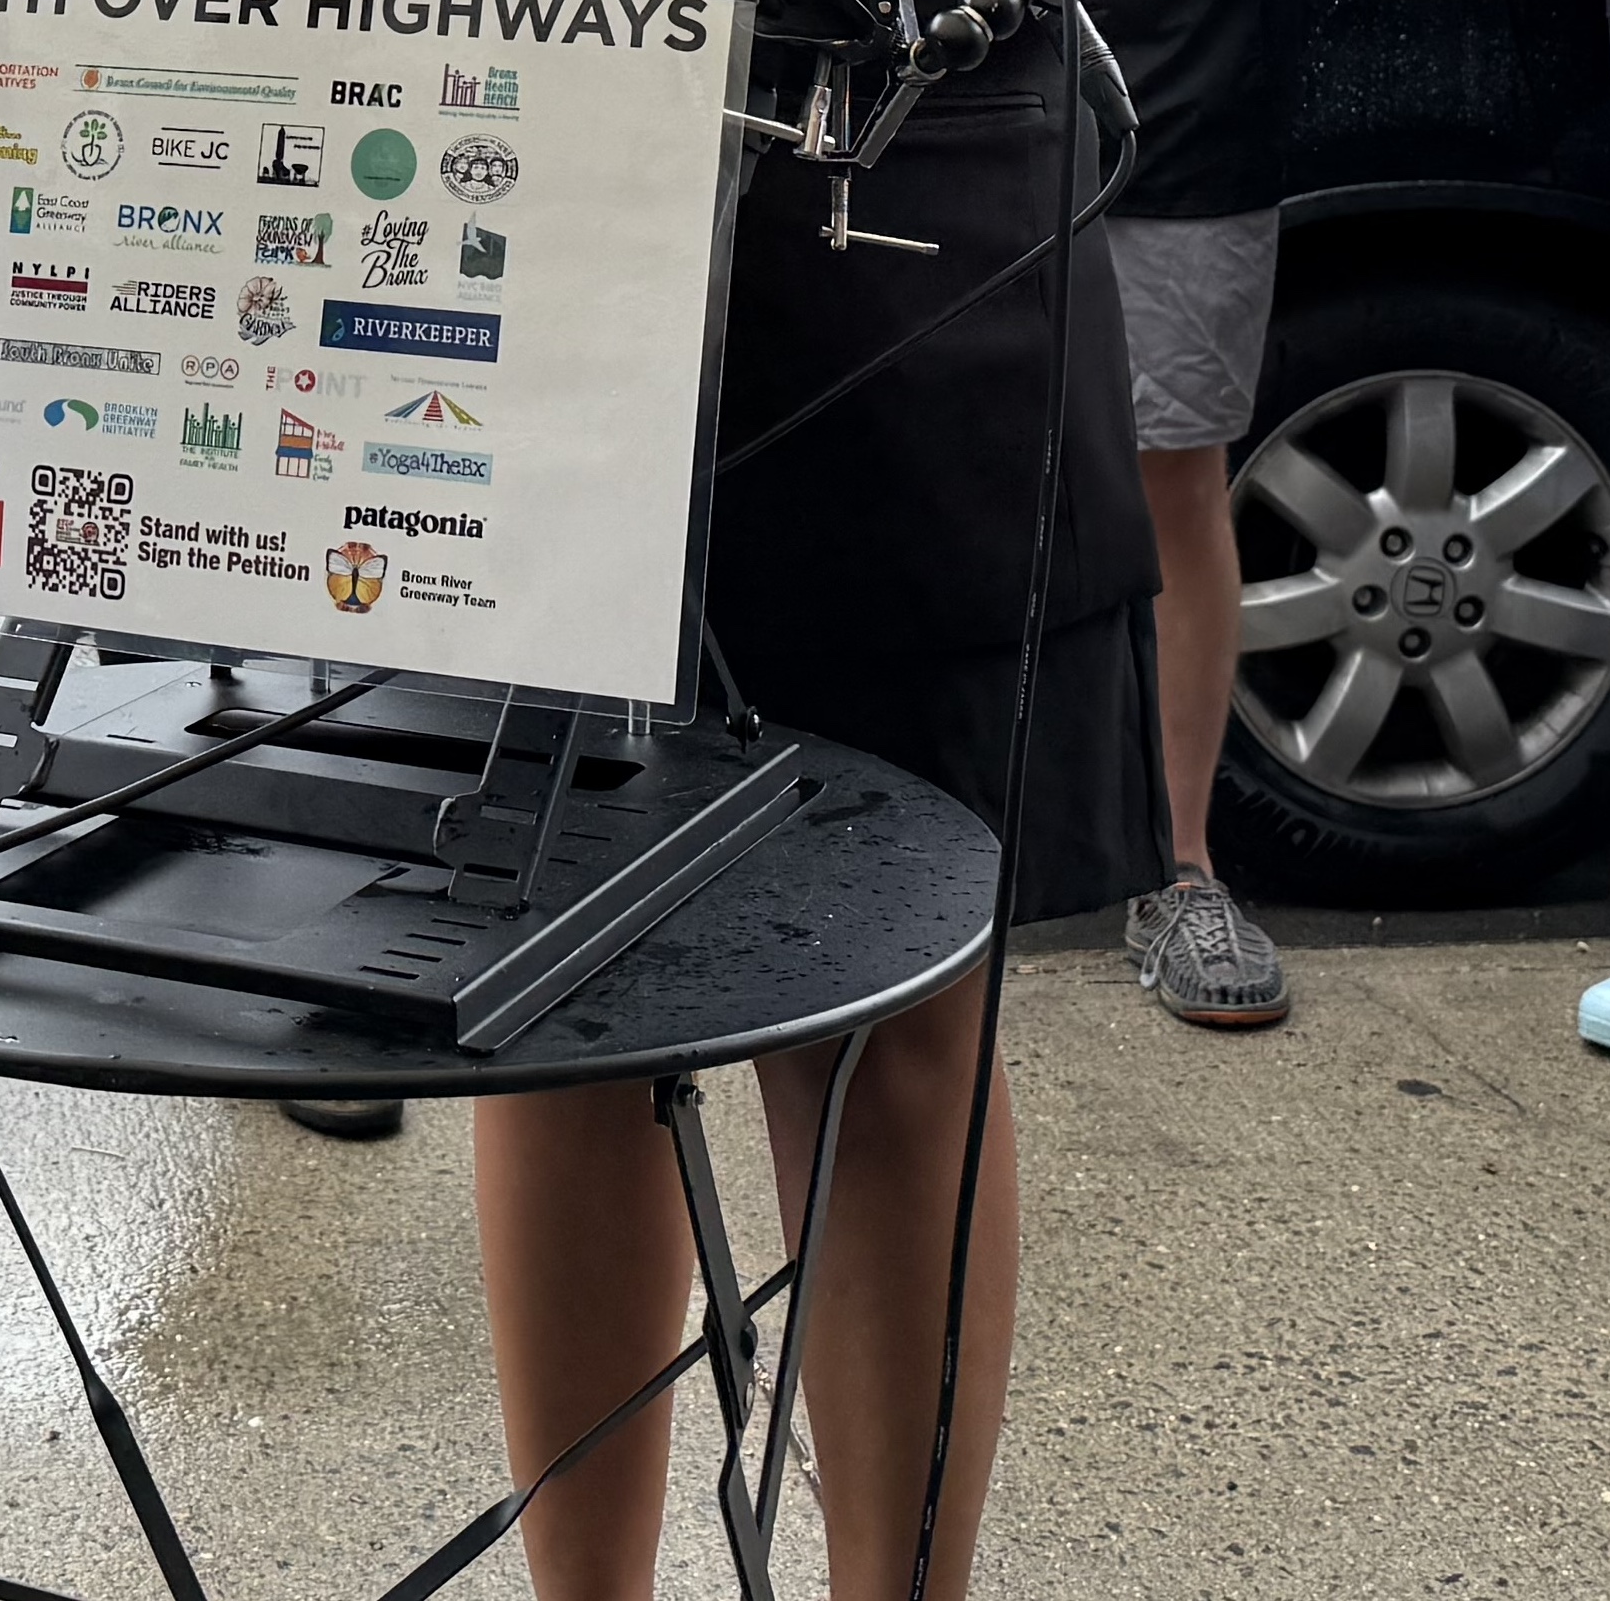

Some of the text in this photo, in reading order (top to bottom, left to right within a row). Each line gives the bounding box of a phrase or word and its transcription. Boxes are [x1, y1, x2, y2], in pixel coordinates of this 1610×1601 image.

[488, 66, 518, 80] Bronx
[331, 80, 403, 108] BRAC
[484, 80, 519, 93] Health
[483, 93, 518, 107] REACH
[151, 137, 230, 161] BIKE JC
[117, 204, 224, 235] BRONX
[361, 210, 429, 246] #Loving
[113, 235, 224, 254] river alliance
[386, 238, 419, 271] The
[361, 250, 429, 288] Bronx
[11, 290, 87, 304] JUSTICE THROUGH
[138, 282, 216, 302] RIDERS
[10, 299, 86, 312] COMMUNITY POWER
[110, 296, 215, 319] ALLIANCE
[353, 317, 491, 347] RIVERKEEPER
[0, 340, 154, 373] South Bronx Unite
[266, 366, 276, 391] THE
[104, 402, 158, 417] BROOKLYN
[101, 425, 156, 439] INITIATIVE
[103, 415, 158, 428] GREENWAY
[368, 449, 487, 479] #Yoga4TheBx
[343, 505, 485, 539] patagonia
[139, 515, 287, 553] Stand with us!
[138, 541, 310, 582] Sign the Petition
[401, 569, 473, 591] Bronx River
[399, 586, 496, 609] Greenway Team
